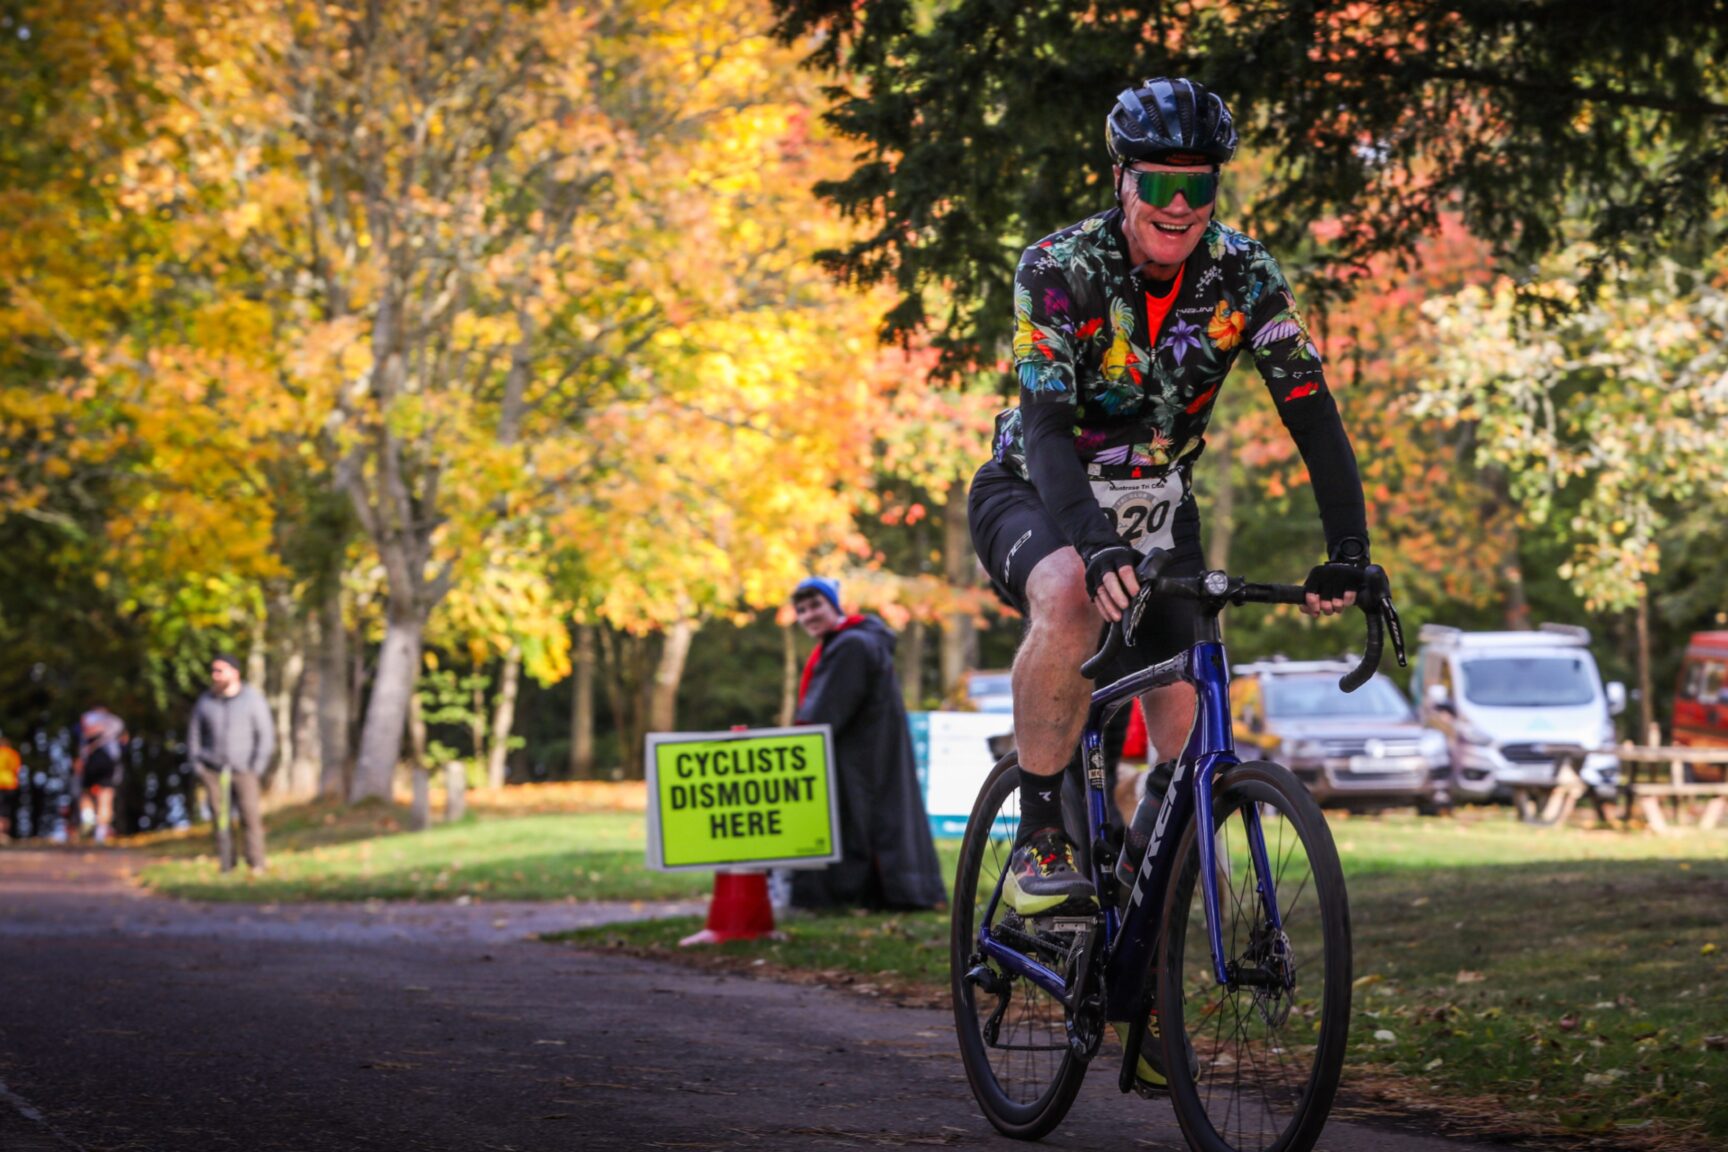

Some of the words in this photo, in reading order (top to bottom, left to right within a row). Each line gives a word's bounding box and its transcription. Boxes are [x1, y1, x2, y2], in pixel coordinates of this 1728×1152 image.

[676, 746, 807, 779] CYCLISTS
[670, 776, 817, 811] DISMOUNT
[710, 810, 782, 839] HERE
[1132, 764, 1187, 908] TREK
